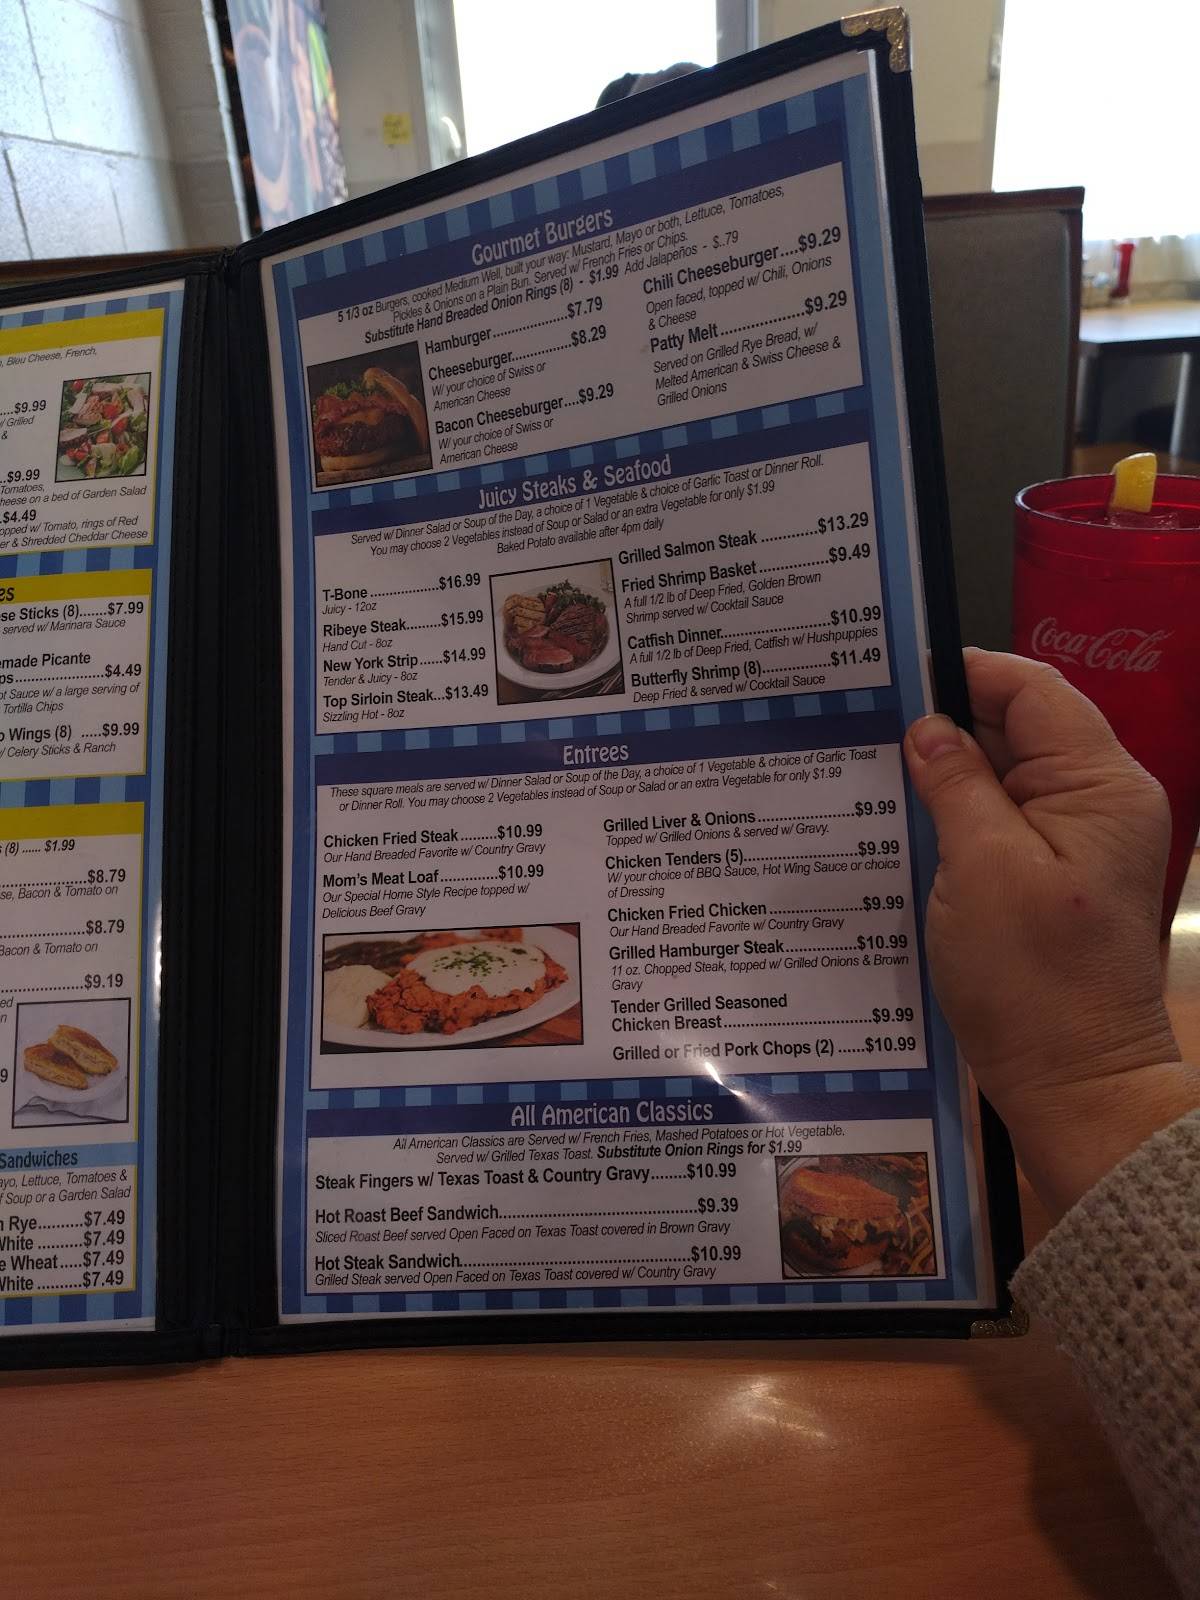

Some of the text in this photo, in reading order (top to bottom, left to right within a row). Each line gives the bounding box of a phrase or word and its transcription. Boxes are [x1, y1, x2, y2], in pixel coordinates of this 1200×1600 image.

[471, 208, 613, 266] Gourmet Burgers
[642, 272, 674, 294] Chili
[364, 322, 415, 344] Substitute
[416, 311, 443, 331] Hand
[445, 299, 489, 324] Breaded
[491, 293, 523, 311] Onion
[525, 284, 557, 302] Rings
[559, 276, 574, 296] (8)
[589, 263, 619, 285] $1.99
[624, 257, 644, 275] Add
[650, 333, 685, 353] Patty
[653, 321, 818, 373] Served on Grilled Rye Bread, w/
[435, 417, 474, 435] Bacon
[478, 453, 671, 509] Juicy Steaks & Seafood
[11, 537, 19, 548] &
[110, 530, 148, 540] Cheese
[496, 518, 664, 554] Baked Potato available after 4pm daily
[618, 544, 661, 565] Grilled
[663, 539, 715, 558] Salmon
[718, 529, 758, 549] Steak
[621, 574, 655, 593] Fried
[658, 570, 706, 588] Shrimp
[322, 588, 368, 602] T-Bone
[19, 606, 59, 620] Sticks
[2, 622, 35, 635] served
[36, 621, 50, 632] w/
[94, 618, 126, 629] Sauce
[323, 623, 367, 638] Ribeye
[627, 631, 675, 650] Catfish
[1031, 617, 1176, 673] Coca-Cola
[41, 652, 91, 666] Picante
[323, 659, 352, 673] New
[354, 656, 384, 670] York
[387, 653, 418, 669] Strip
[630, 668, 688, 687] Butterfly
[691, 664, 740, 681] Shrimp
[322, 694, 347, 710] Top
[350, 691, 393, 706] Sirloin
[8, 724, 72, 743] Wings (8)
[7, 742, 116, 758] Celery Sticks & Ranch
[563, 744, 629, 765] Entrees
[603, 816, 649, 832] Grilled
[652, 815, 687, 829] Liver
[690, 813, 702, 827] &
[4, 839, 75, 857] (8) $1.99
[323, 833, 378, 848] Chicken
[382, 830, 417, 845] Fried
[605, 854, 661, 870] Chicken
[664, 850, 722, 866] Tenders
[371, 871, 405, 885] Meat
[607, 906, 664, 922] Chicken
[668, 903, 705, 919] Fried
[608, 944, 655, 960] Grilled
[659, 942, 740, 959] Hamburger
[610, 993, 787, 1014] Tender Grilled Seasoned
[611, 1016, 670, 1032] Chicken
[612, 1044, 660, 1061] Grilled
[664, 1047, 680, 1059] or
[683, 1042, 721, 1058] Fried
[724, 1041, 759, 1057] Pork
[762, 1040, 811, 1058] Chops
[815, 1038, 834, 1058] (2)
[510, 1099, 713, 1126] All American Classics
[315, 1173, 355, 1190] Steak
[359, 1173, 414, 1192] Fingers
[417, 1171, 434, 1187] w/
[437, 1171, 480, 1186] Texas
[483, 1169, 524, 1185] Toast
[527, 1168, 539, 1184] &
[542, 1167, 602, 1185] Country
[315, 1208, 340, 1224] Hot
[344, 1208, 386, 1223] Roast
[390, 1205, 424, 1222] Beef
[314, 1255, 340, 1271] Hot
[343, 1254, 384, 1270] Steak
